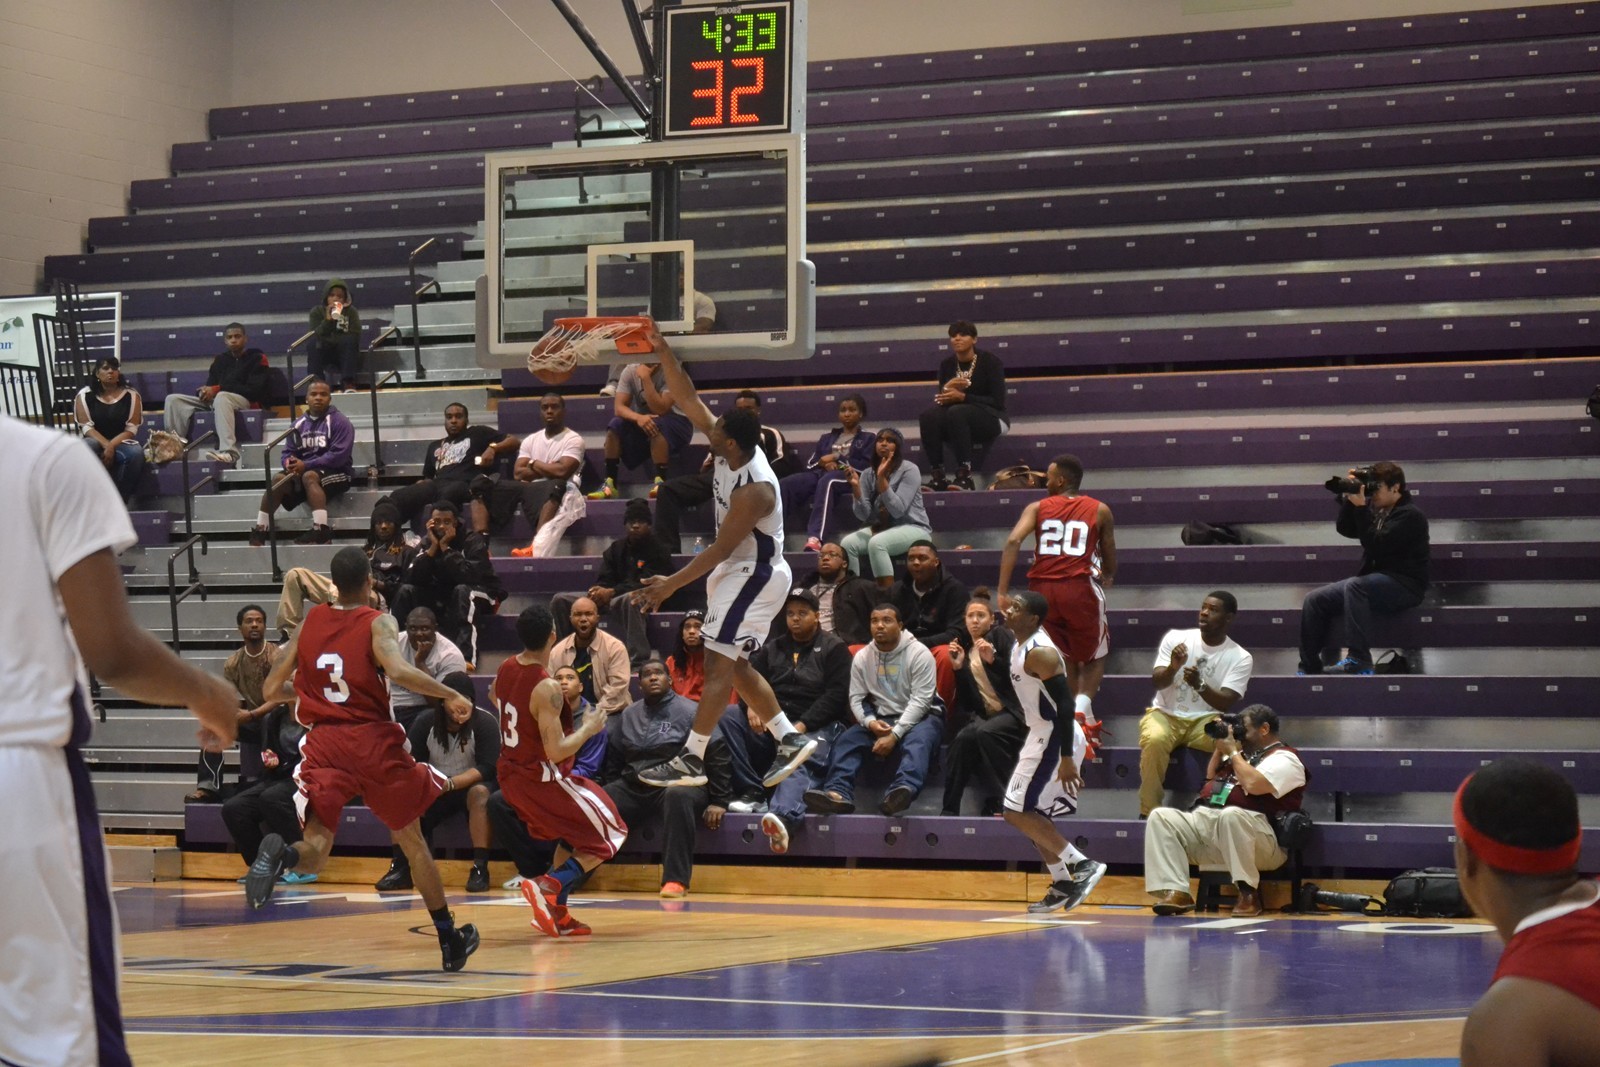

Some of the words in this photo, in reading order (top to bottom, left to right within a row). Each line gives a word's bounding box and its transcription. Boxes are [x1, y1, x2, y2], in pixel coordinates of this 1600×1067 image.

[702, 12, 776, 53] 4:33
[690, 57, 764, 126] 32
[1039, 519, 1089, 556] 20
[316, 653, 350, 703] 3
